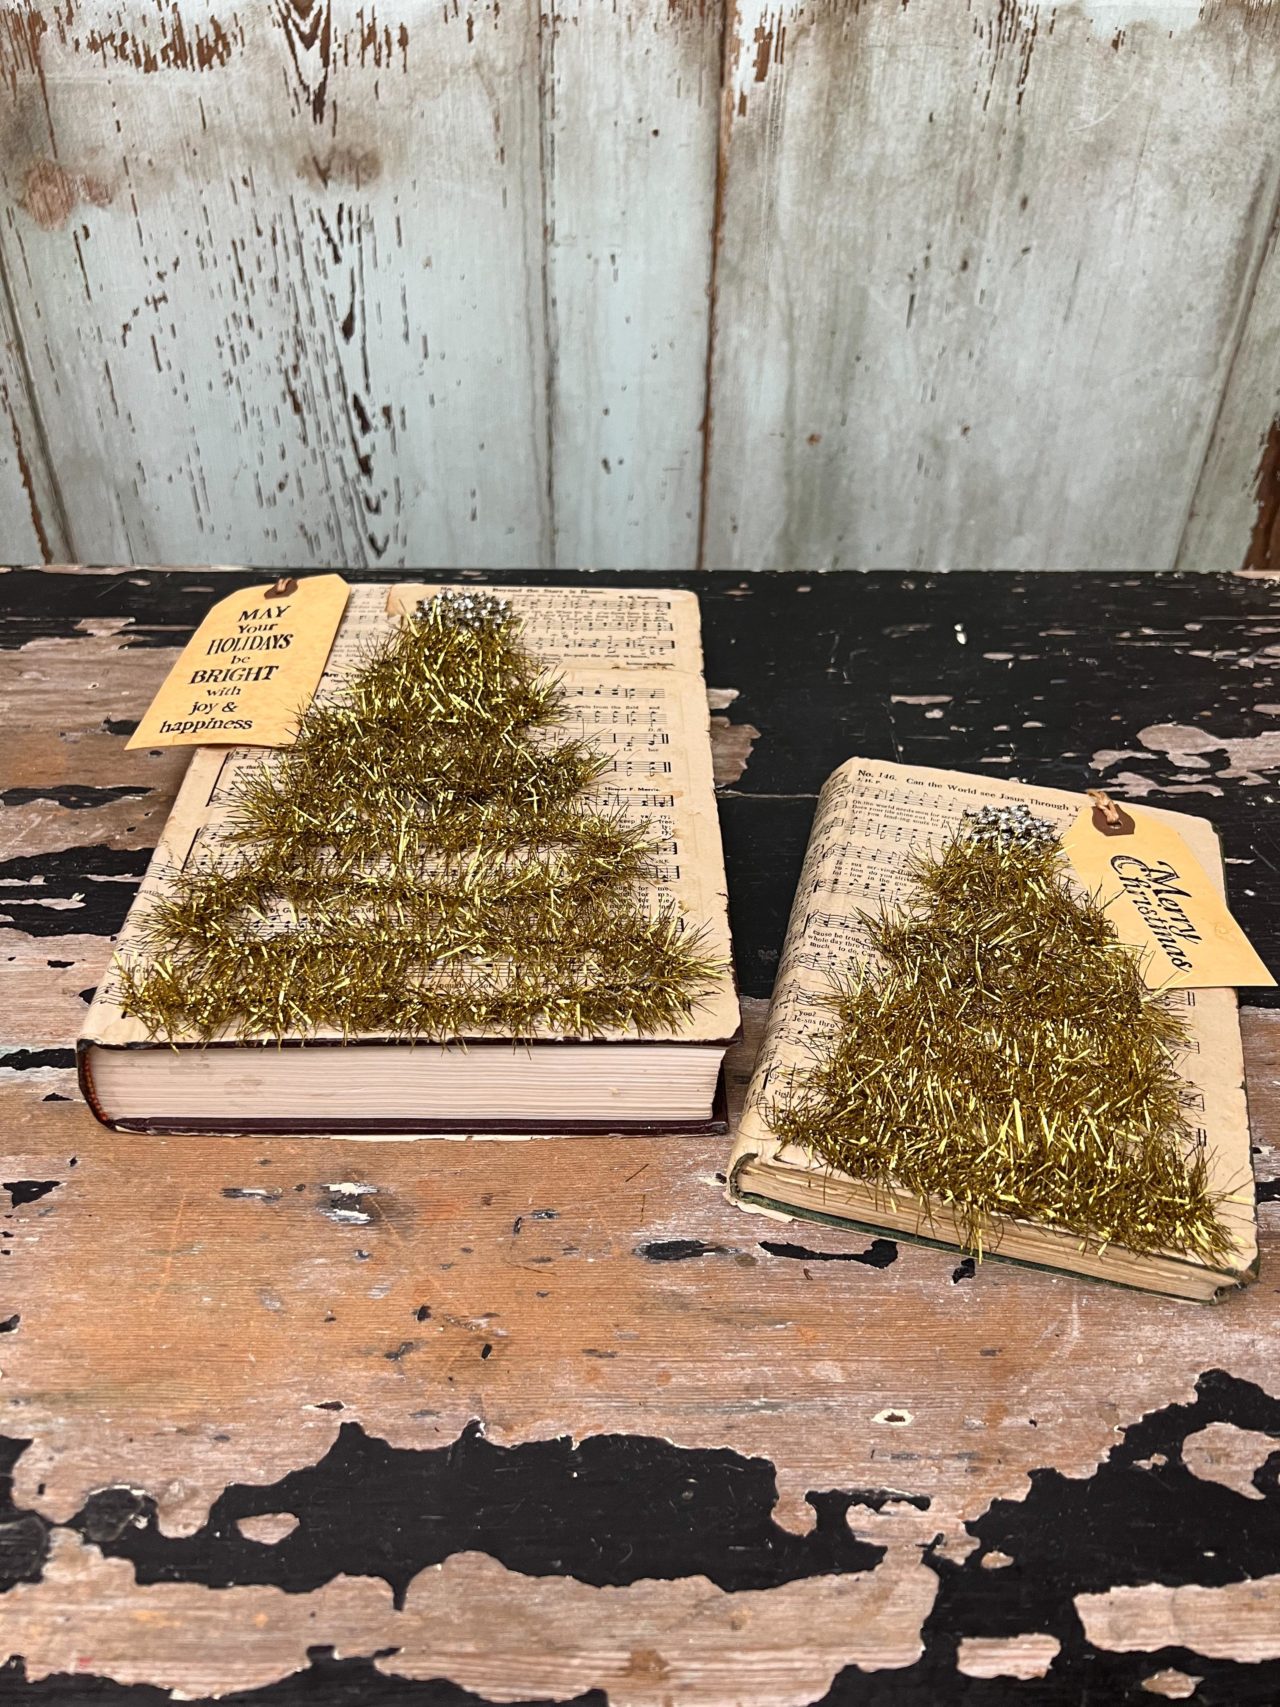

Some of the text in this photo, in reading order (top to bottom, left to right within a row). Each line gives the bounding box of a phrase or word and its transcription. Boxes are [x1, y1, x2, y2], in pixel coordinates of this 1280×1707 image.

[237, 605, 291, 622] MAY
[238, 623, 279, 634] Your
[205, 633, 294, 656] HOLIDAYS
[230, 655, 250, 665] be
[188, 665, 279, 684] BRIGHT
[206, 685, 241, 696] with
[188, 701, 238, 716] joy &
[159, 718, 253, 735] happiness
[857, 769, 874, 778] No.
[879, 772, 897, 781] 146.
[906, 778, 924, 786] Can
[947, 784, 977, 795] World
[1030, 798, 1069, 811] Through
[1147, 860, 1203, 945] Merry
[1110, 855, 1193, 973] Christmas
[808, 934, 828, 943] whole
